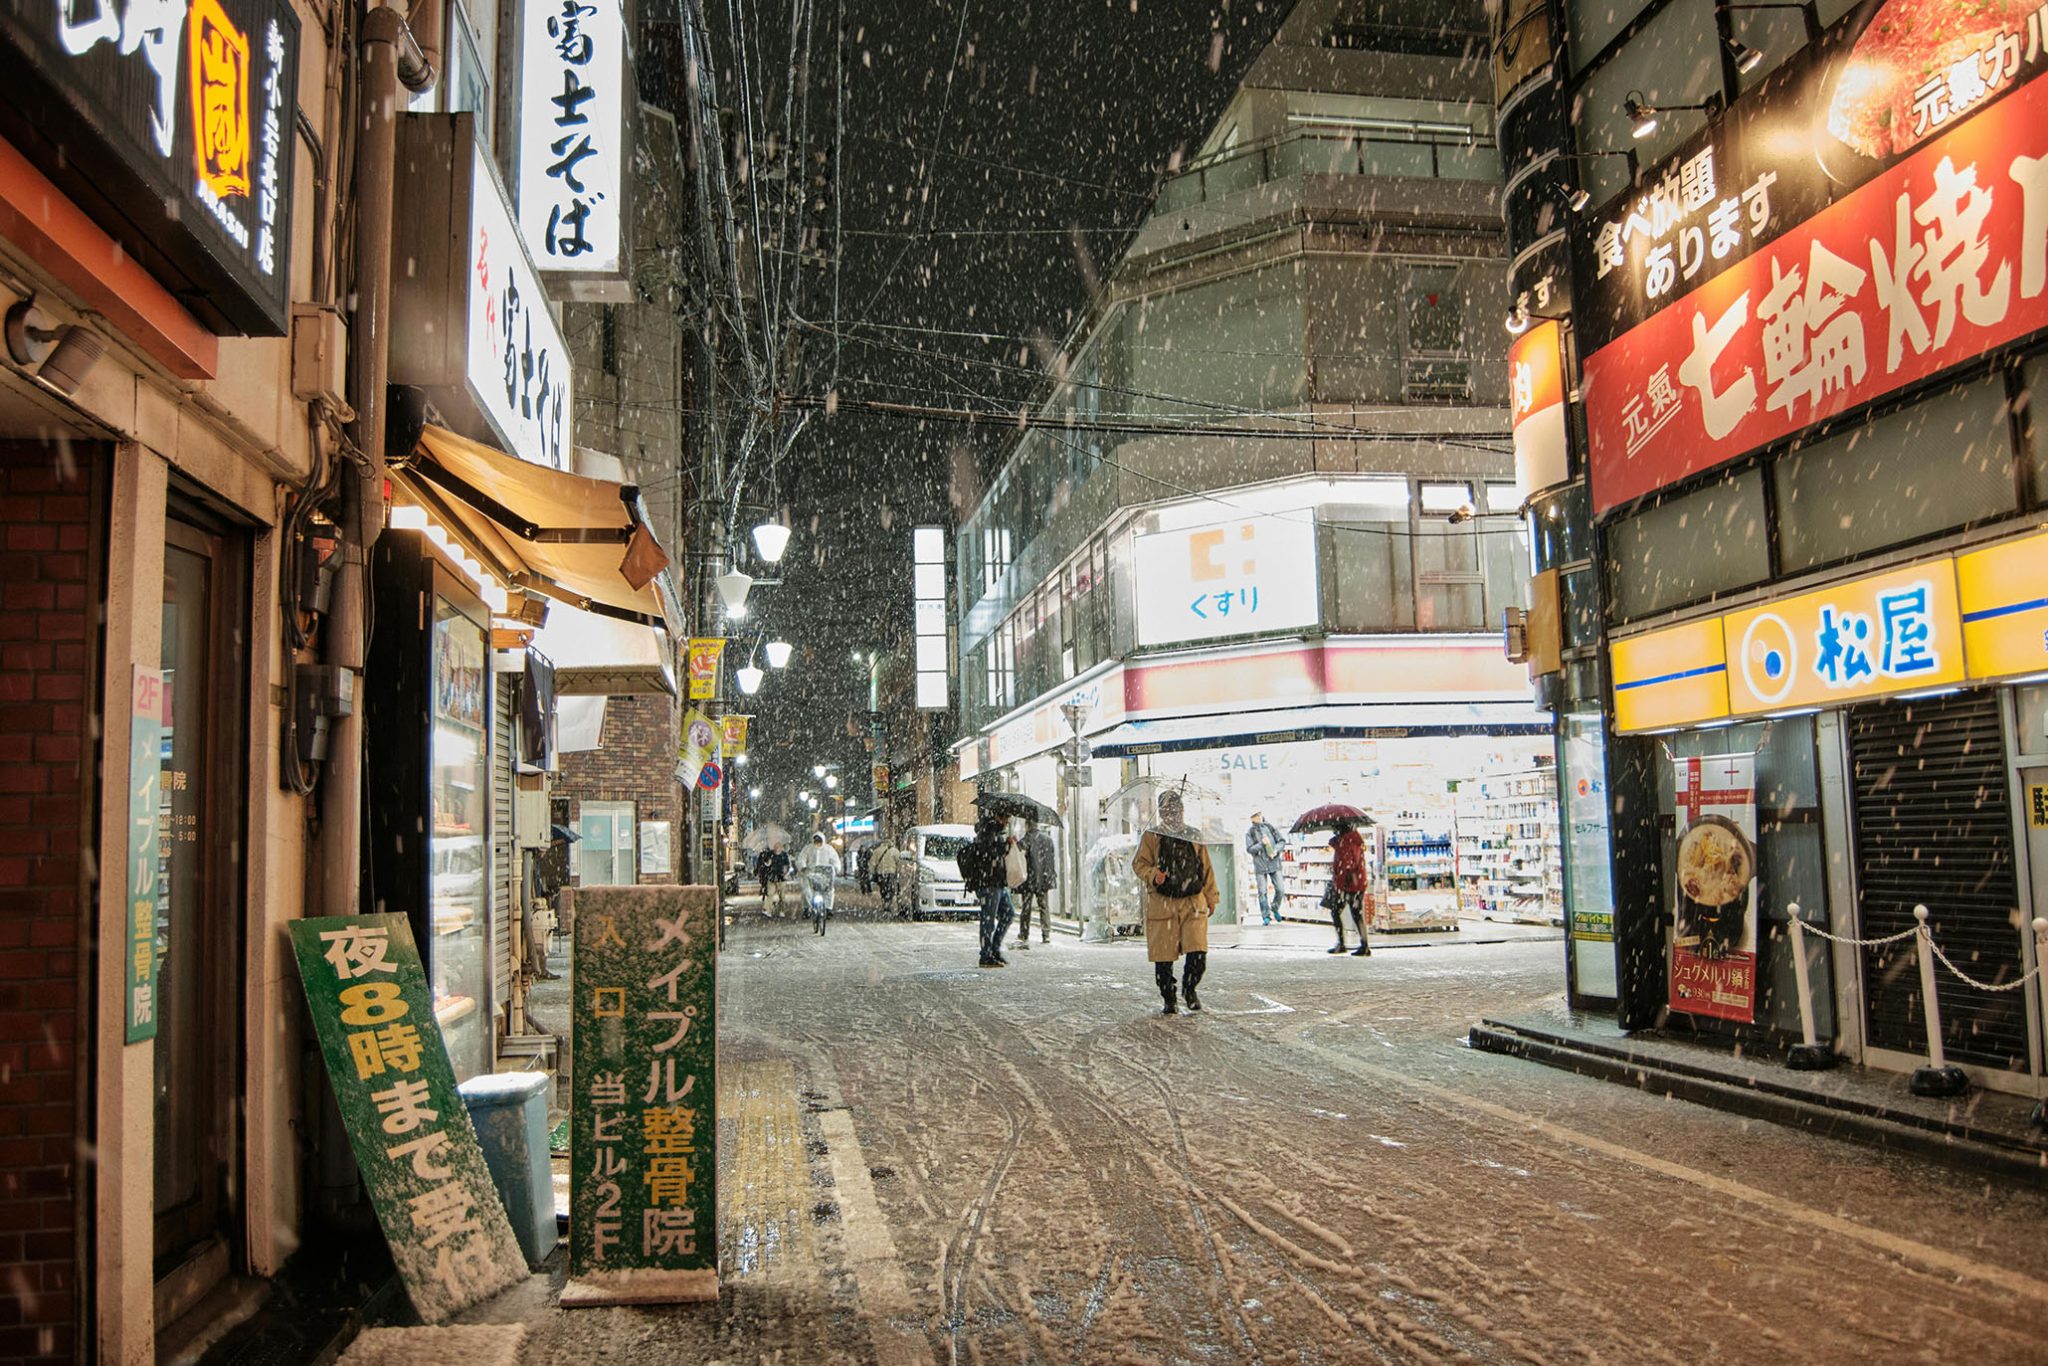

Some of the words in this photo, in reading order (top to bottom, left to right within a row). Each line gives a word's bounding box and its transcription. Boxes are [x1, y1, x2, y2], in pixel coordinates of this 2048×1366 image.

[545, 0, 605, 258] 富士そば
[1596, 146, 1717, 281] 食べ放題
[1644, 171, 1778, 299] あります
[477, 225, 496, 359] 名代
[502, 265, 566, 471] 富士そば
[1190, 585, 1259, 620] くすり
[1816, 581, 1938, 686] 松屋
[137, 673, 160, 712] 2F
[1220, 752, 1268, 770] SALE
[132, 732, 156, 1028] メイプル整骨院
[593, 915, 627, 1018] 入口
[643, 909, 696, 1258] メイプル整骨院
[590, 1071, 627, 1260] 当ビル2F
